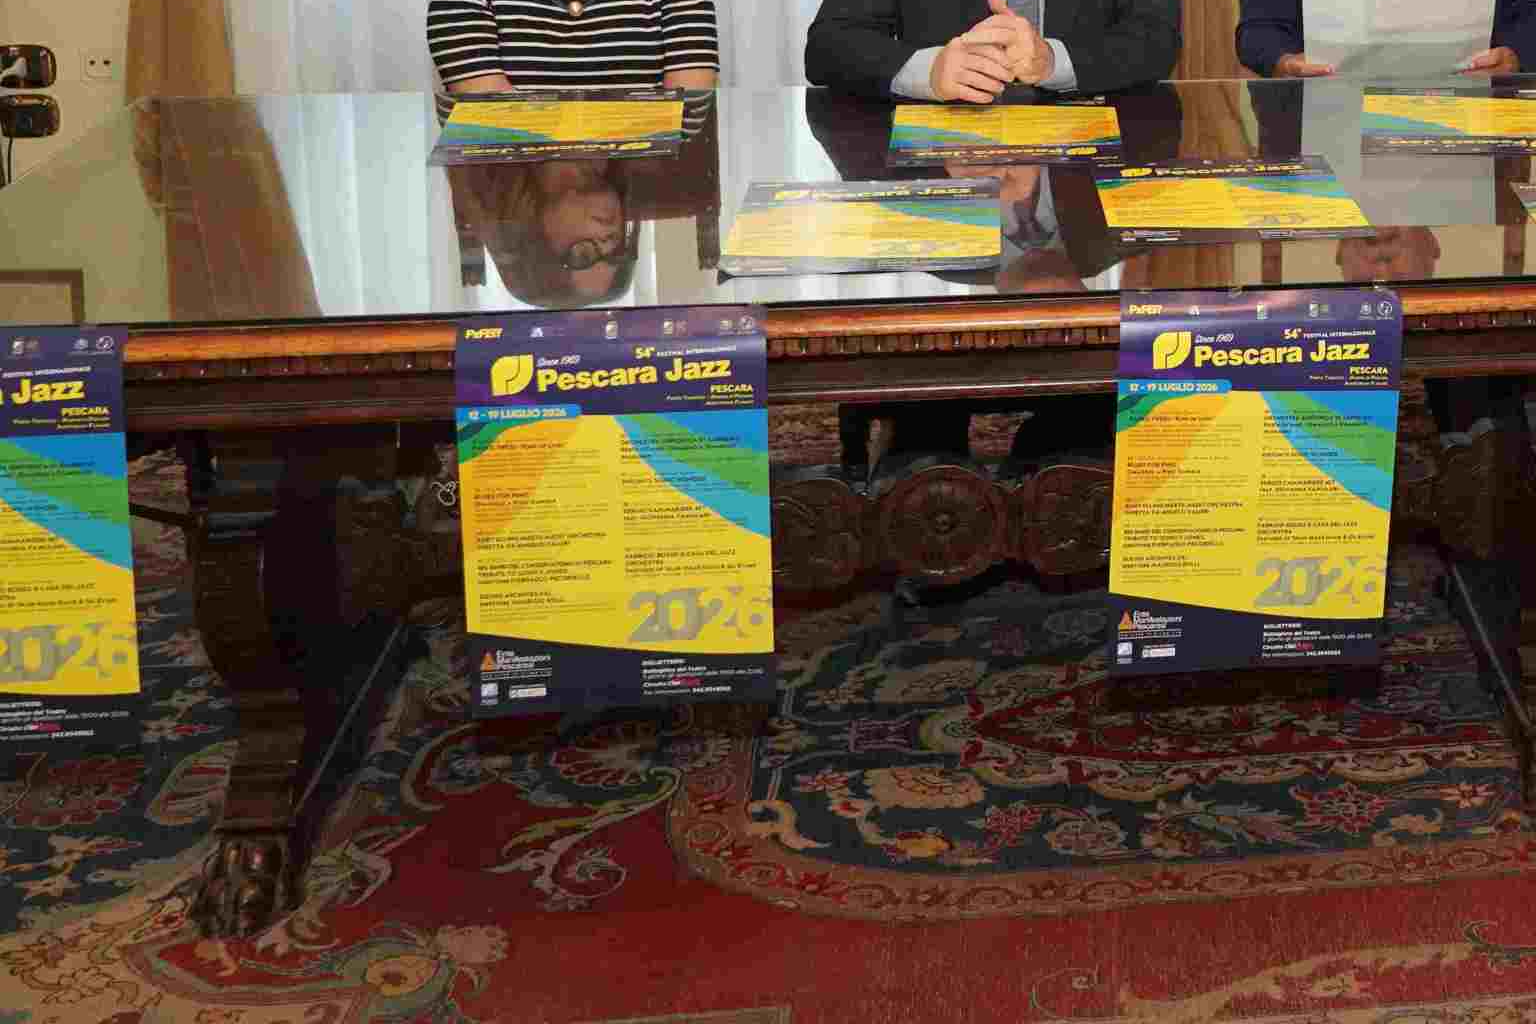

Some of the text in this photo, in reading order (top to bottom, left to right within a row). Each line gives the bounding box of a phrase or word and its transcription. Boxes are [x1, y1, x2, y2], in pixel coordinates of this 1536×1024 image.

[1193, 339, 1371, 368] Pescara Jazz
[535, 358, 732, 393] Pescara Jazz
[1349, 366, 1389, 375] PESCARA
[11, 378, 86, 405] Jazz
[710, 384, 754, 394] PESCARA
[1158, 382, 1195, 392] LUGLIO
